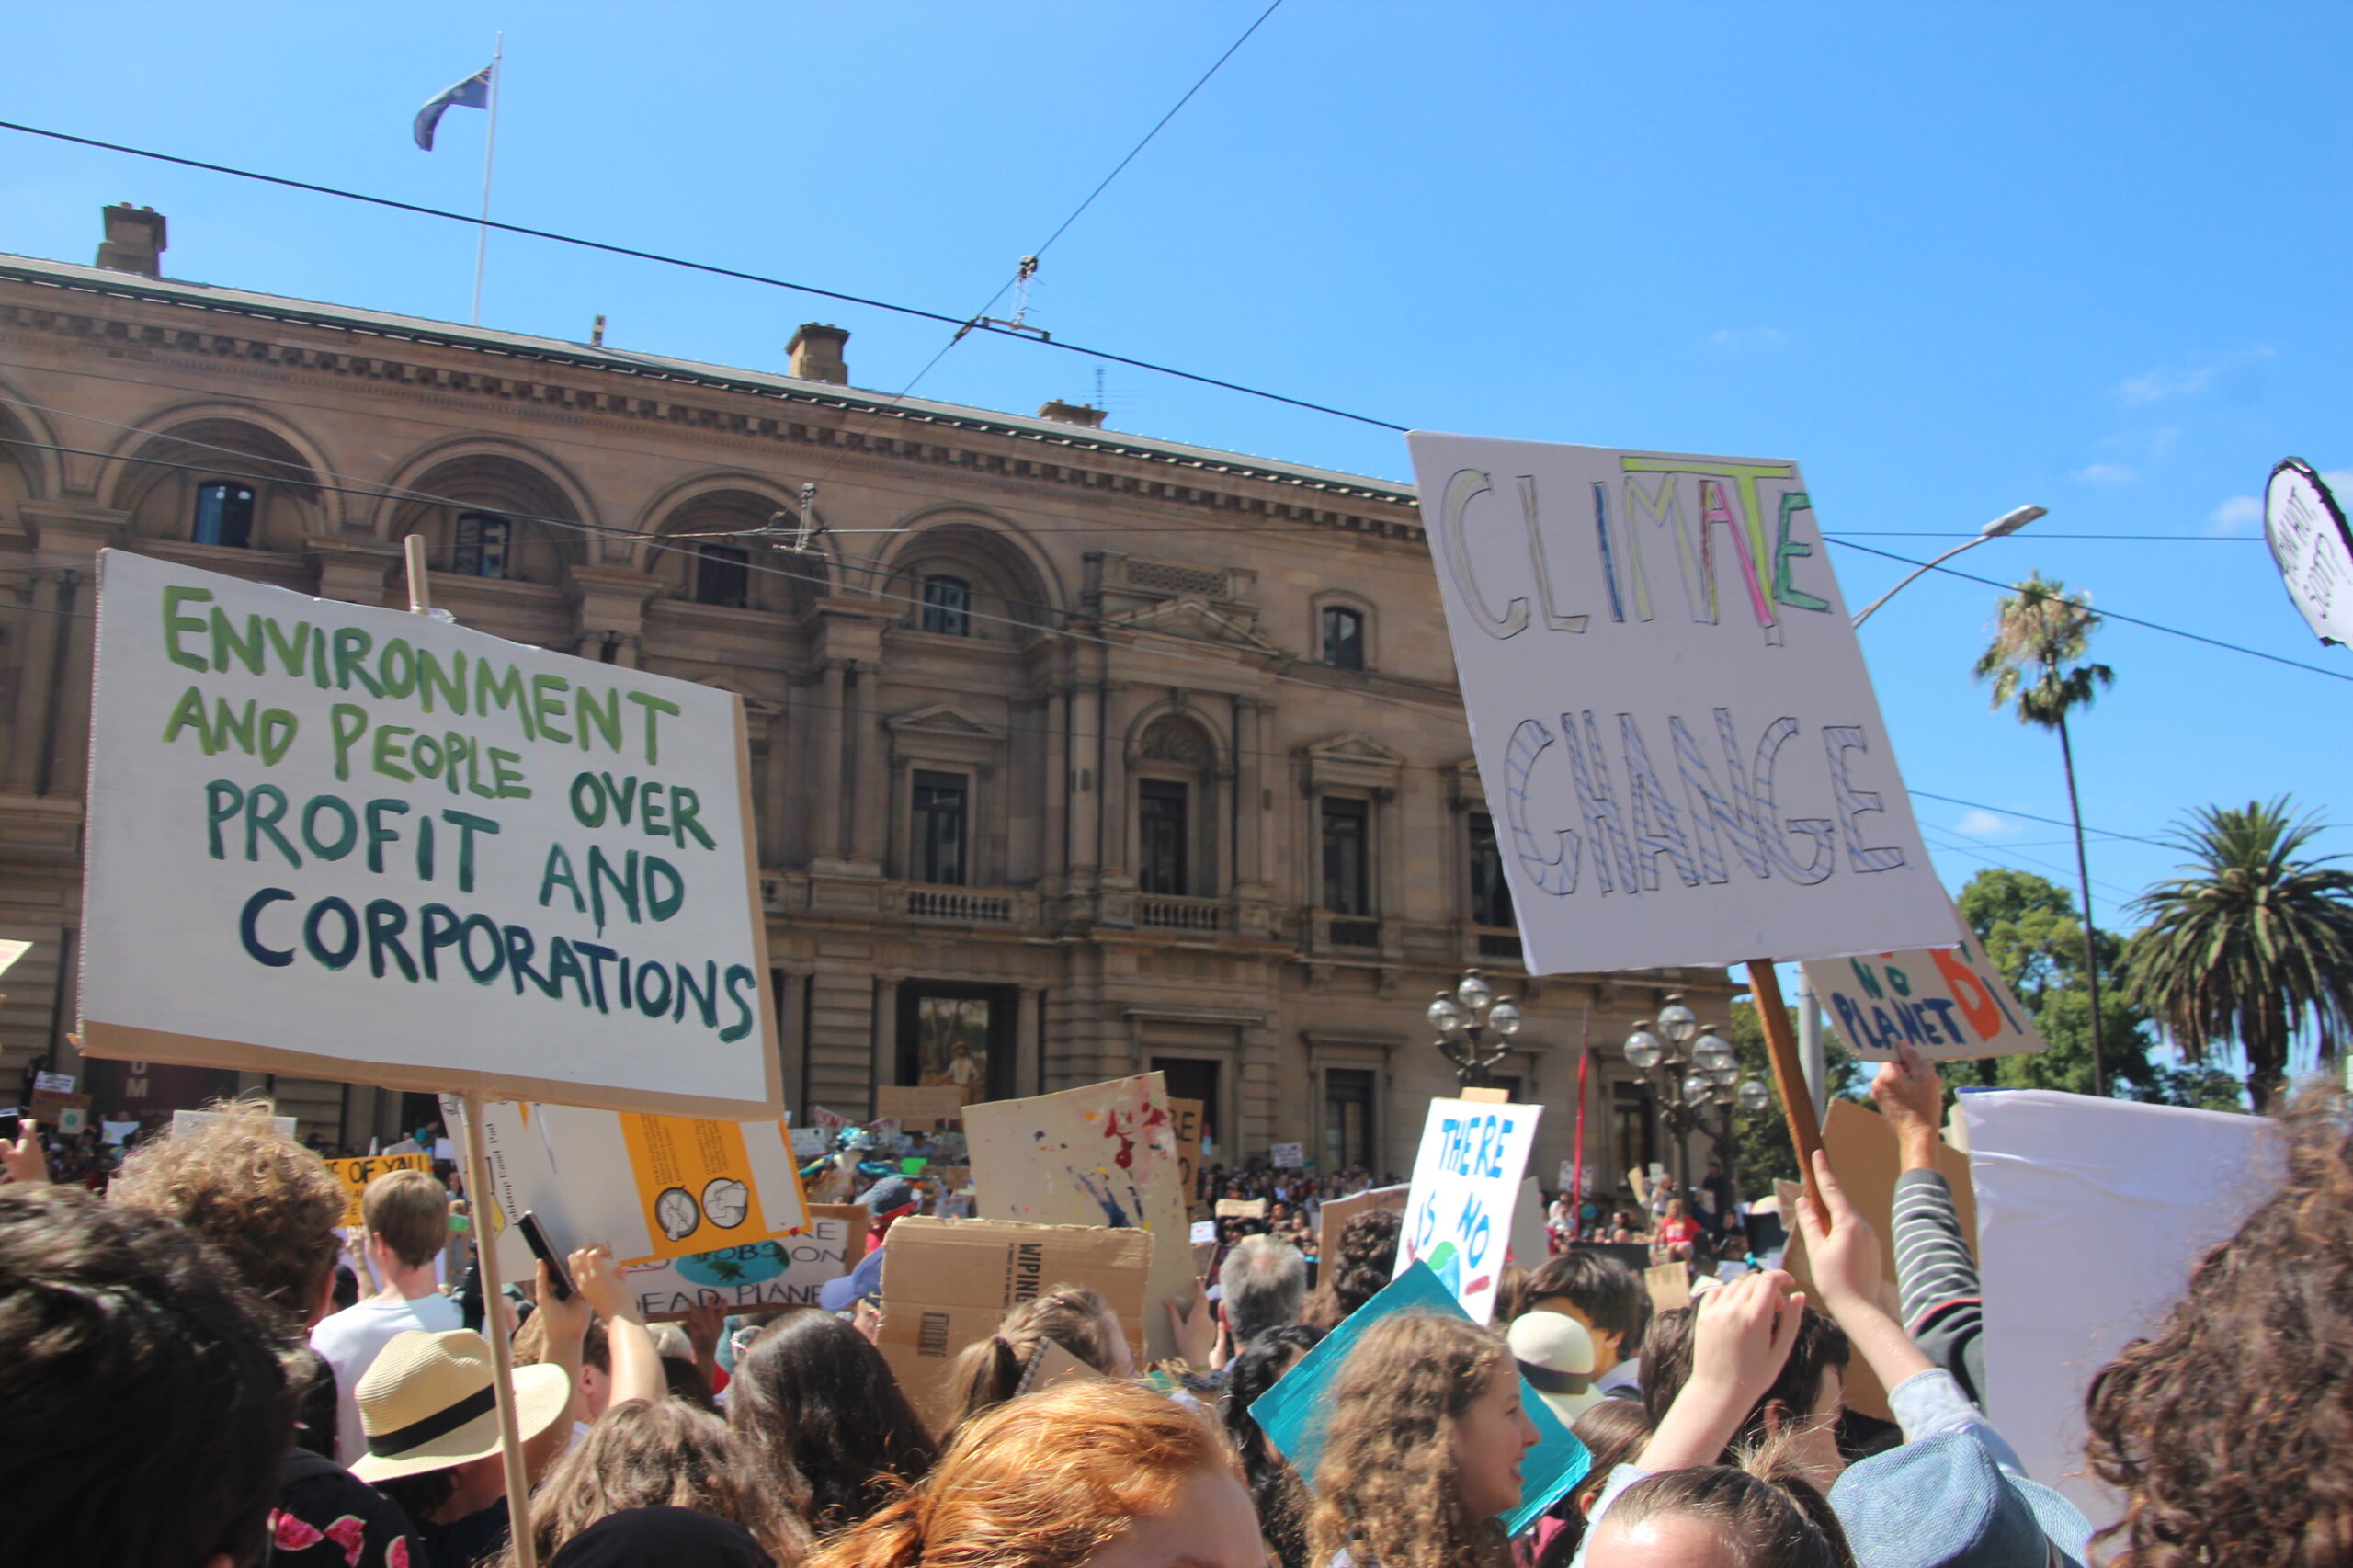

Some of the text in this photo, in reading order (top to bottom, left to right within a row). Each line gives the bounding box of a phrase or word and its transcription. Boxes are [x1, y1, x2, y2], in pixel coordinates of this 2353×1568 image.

[1440, 456, 1832, 646] CLIMATE
[162, 585, 680, 766] ENVIRONMENT
[162, 686, 716, 850] AND PEOPLE OVER
[1504, 707, 1904, 897] CHANGE
[207, 779, 684, 932] PROFIT AND
[240, 887, 756, 1043] CORPORATIONS
[1849, 956, 1911, 1000] NO
[1831, 992, 1967, 1049] PLANET
[349, 1159, 375, 1184] OF
[1438, 1115, 1514, 1178] THERE
[791, 1246, 847, 1264] ON
[1415, 1190, 1489, 1268] IS NO
[636, 1283, 824, 1316] EAD PLANE
[1015, 1244, 1042, 1303] WIPING
